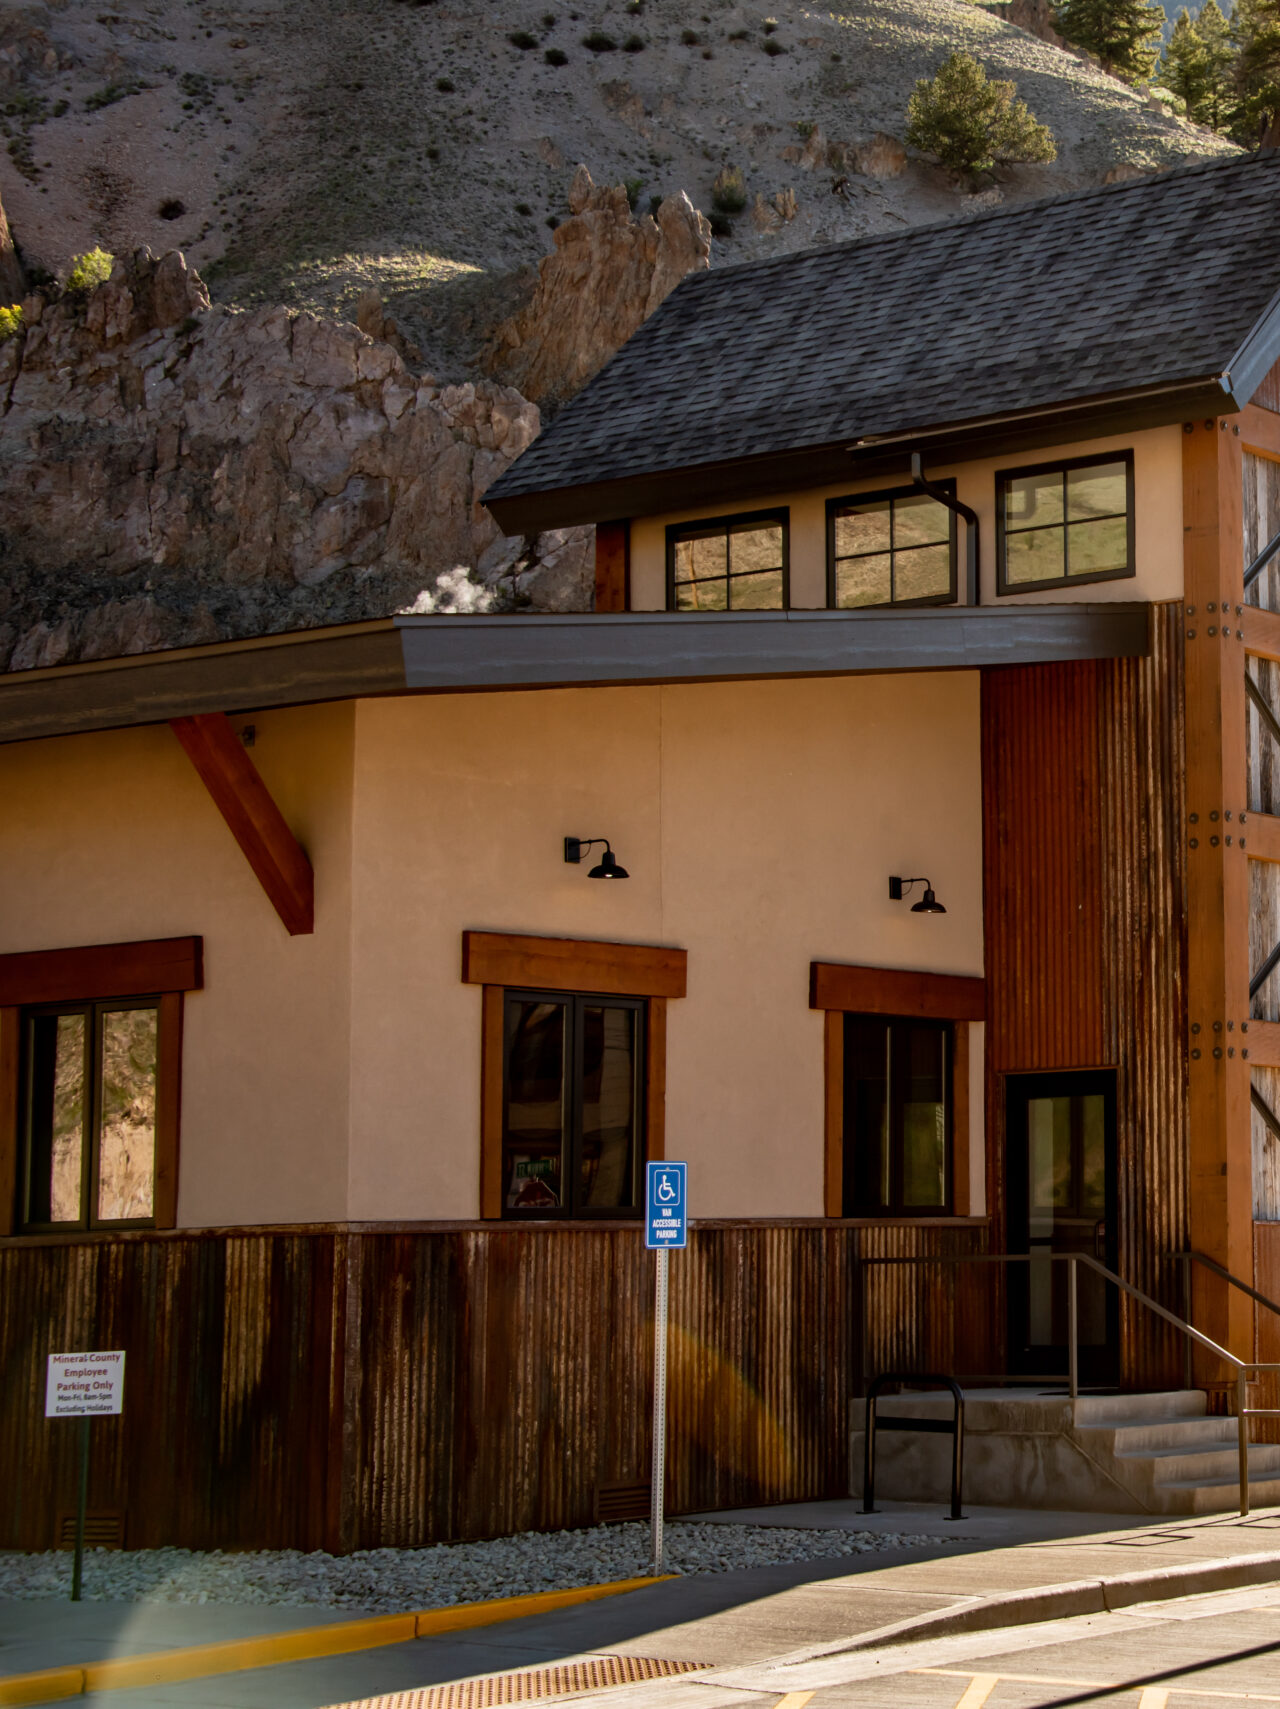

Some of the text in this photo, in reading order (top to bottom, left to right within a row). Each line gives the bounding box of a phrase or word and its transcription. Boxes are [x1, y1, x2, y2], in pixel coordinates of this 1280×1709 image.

[662, 1208, 672, 1217] VAN
[652, 1219, 682, 1228] ACCESSIBLE
[656, 1229, 678, 1239] PARKING
[53, 1353, 121, 1364] Mineral County
[64, 1368, 108, 1378] Employee
[57, 1381, 114, 1392] Parking Only
[55, 1404, 113, 1413] Excluding Holidays
